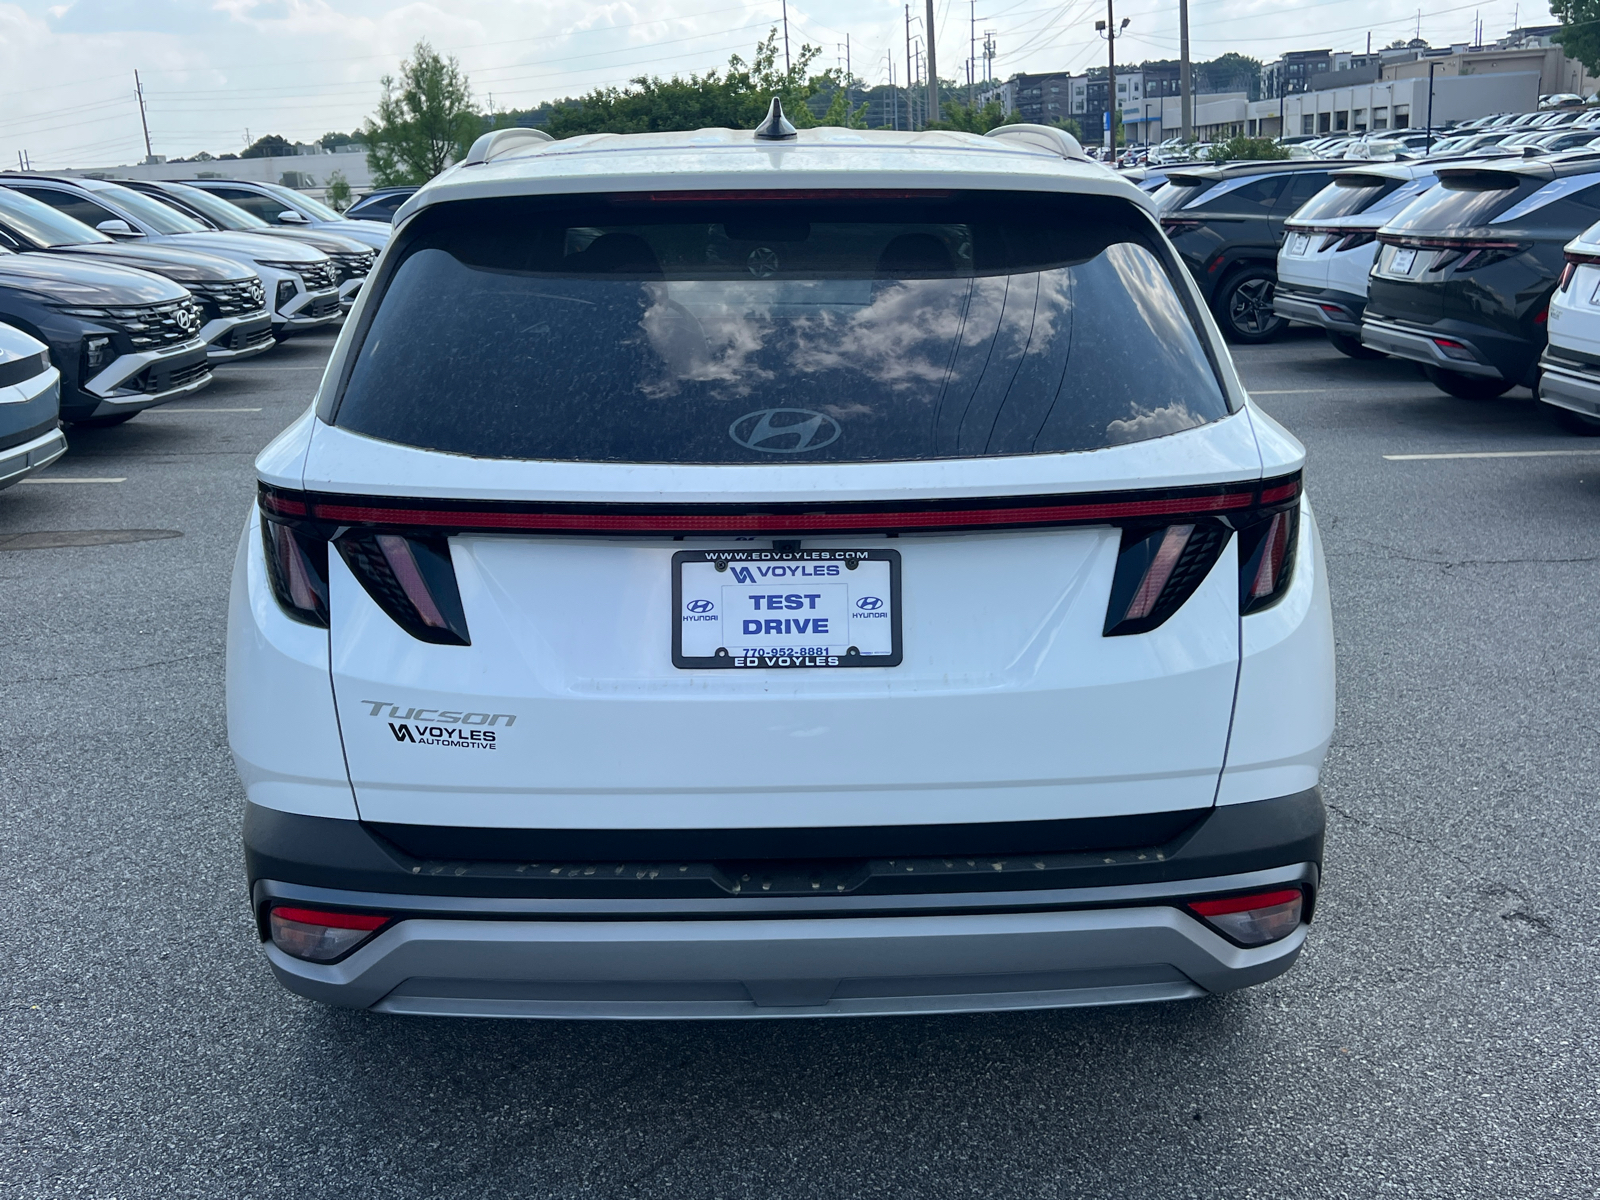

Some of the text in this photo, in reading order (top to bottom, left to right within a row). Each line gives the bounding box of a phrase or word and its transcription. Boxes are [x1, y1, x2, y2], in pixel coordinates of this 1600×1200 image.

[705, 552, 868, 560] WWW.EDVOYLES.COM
[757, 565, 840, 577] VOYLES
[748, 594, 821, 611] TEST
[742, 618, 829, 635] DRIVE
[743, 647, 829, 657] 770-952-8881
[734, 656, 839, 667] ED VOYLES
[415, 725, 496, 742] VOYLES
[418, 737, 497, 750] AUTOMOTIVE
